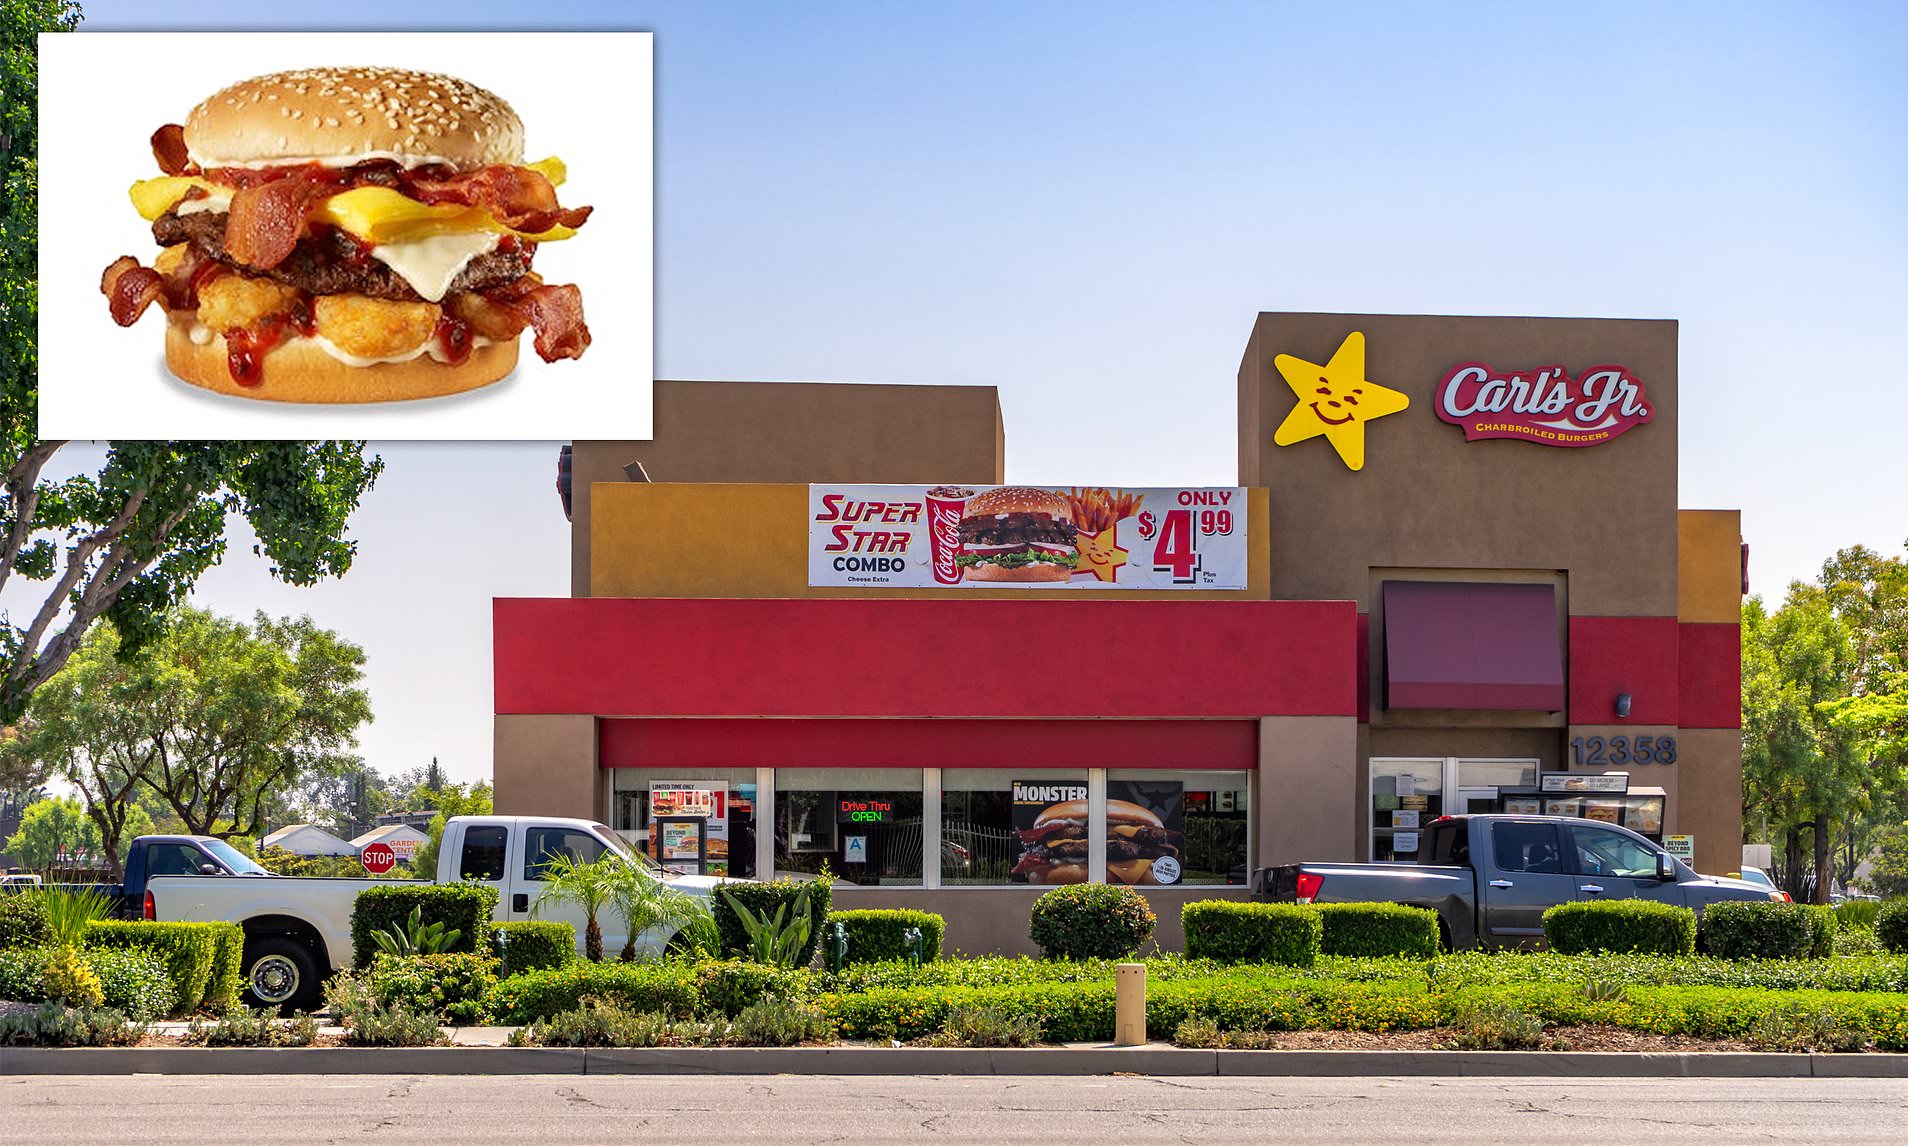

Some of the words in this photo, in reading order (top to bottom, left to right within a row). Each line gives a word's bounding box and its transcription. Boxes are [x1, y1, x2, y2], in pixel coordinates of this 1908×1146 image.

[1443, 367, 1574, 417] Carl's
[1574, 371, 1648, 422] Jr.
[1475, 422, 1555, 440] CHARBROILED
[1557, 431, 1609, 442] BURGERS
[1177, 491, 1232, 506] ONLY
[815, 494, 923, 525] SUPER
[824, 524, 912, 555] STAR
[833, 556, 905, 573] COMBO
[847, 575, 871, 583] Cheese
[872, 575, 890, 583] Extra
[1570, 735, 1677, 765] 12358
[1013, 786, 1088, 801] MONSTER
[841, 801, 867, 811] Drive
[869, 801, 891, 811] Thru
[851, 811, 882, 821] OPEN
[850, 837, 862, 850] A
[364, 852, 393, 864] STOP
